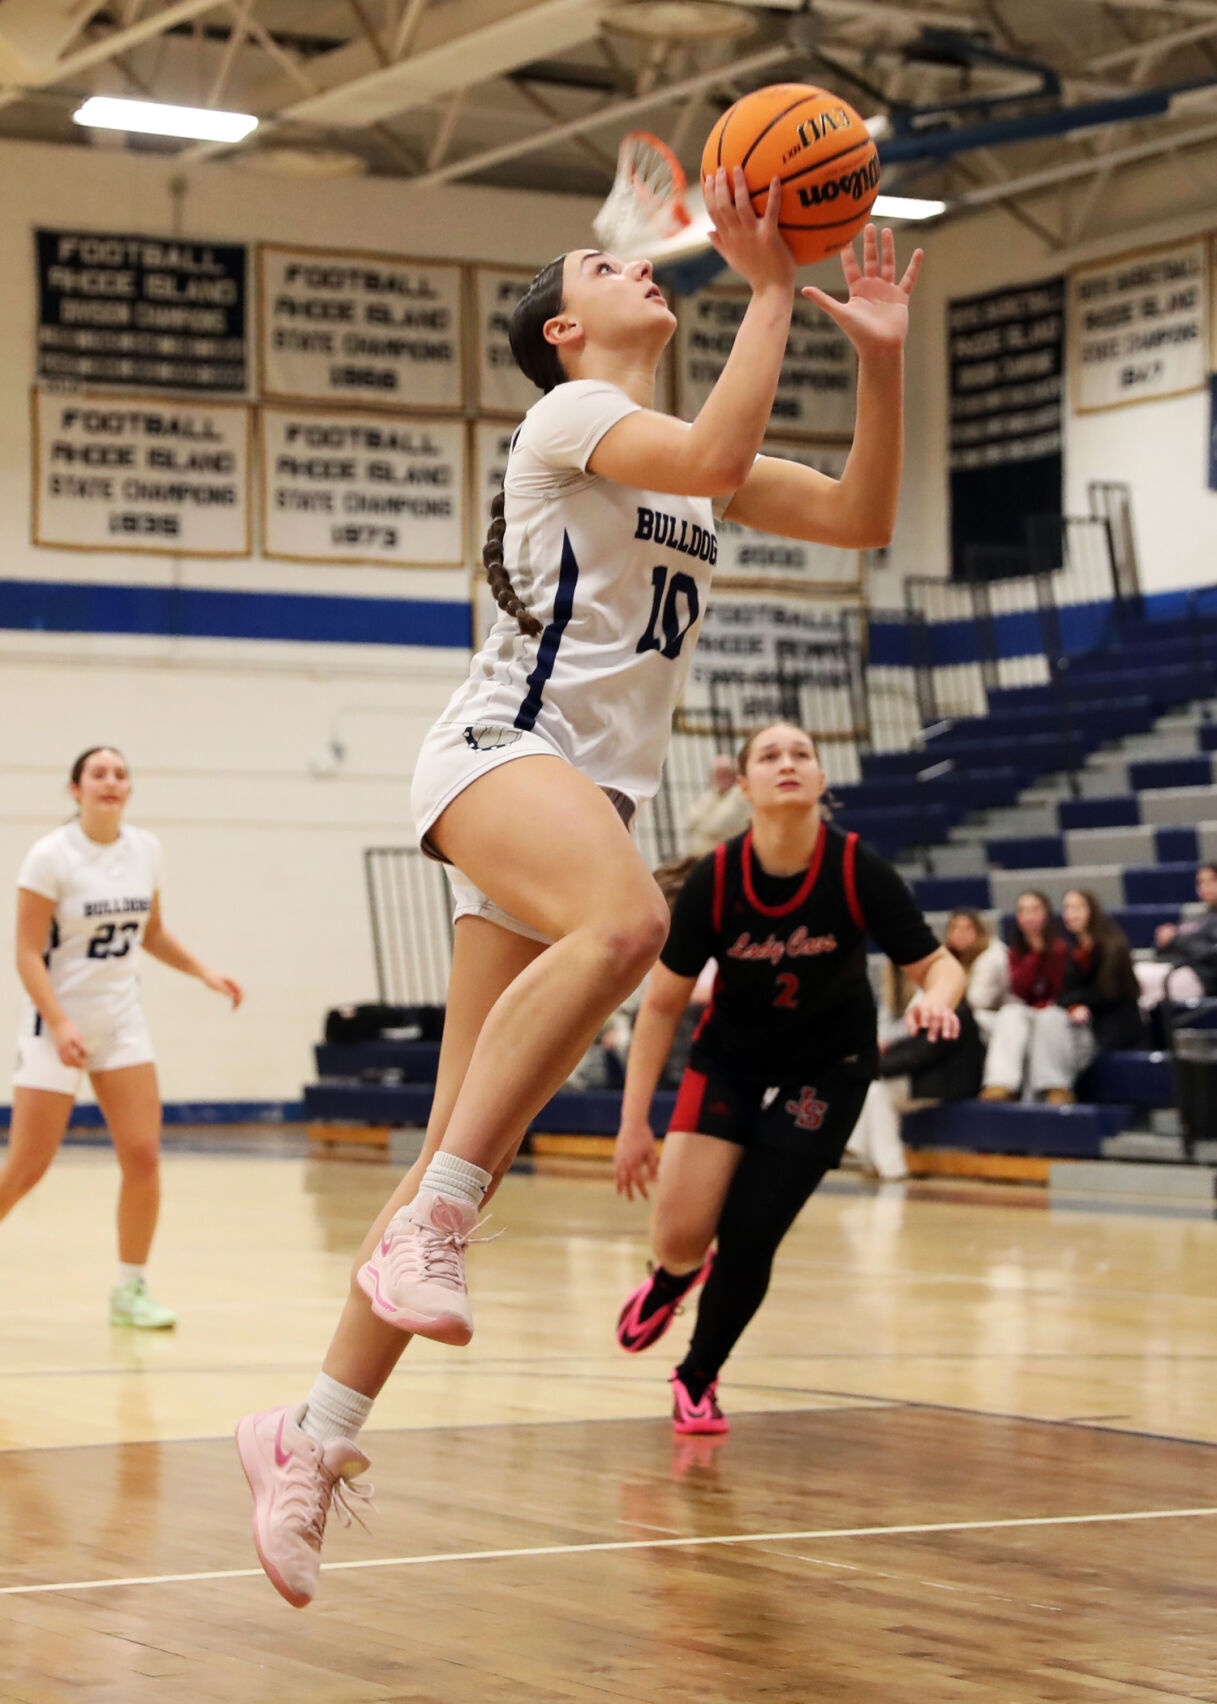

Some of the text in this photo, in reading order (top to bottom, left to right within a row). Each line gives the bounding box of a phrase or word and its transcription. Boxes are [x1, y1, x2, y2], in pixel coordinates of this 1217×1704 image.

[58, 237, 226, 275] FOOTBALL
[48, 265, 238, 305] RHODE ISLAND
[285, 264, 437, 300] FOOTBALL
[275, 296, 450, 331] RHODE ISLAND
[274, 326, 333, 354] STATE
[342, 332, 452, 364] CHAMPIONS
[61, 408, 223, 442] FOOTBALL
[285, 422, 440, 456] FOOTBALL
[52, 441, 235, 475] RHODE ISLAND
[275, 454, 451, 487] RHODE ISLAND
[50, 473, 236, 507] STATE CHAMPIONS
[275, 487, 452, 519] STATE CHAMPIONS
[634, 506, 718, 566] BULLDOG
[635, 565, 700, 661] 10
[86, 922, 139, 959] 23
[727, 925, 838, 966] Lady Cavs
[773, 972, 799, 1008] 2
